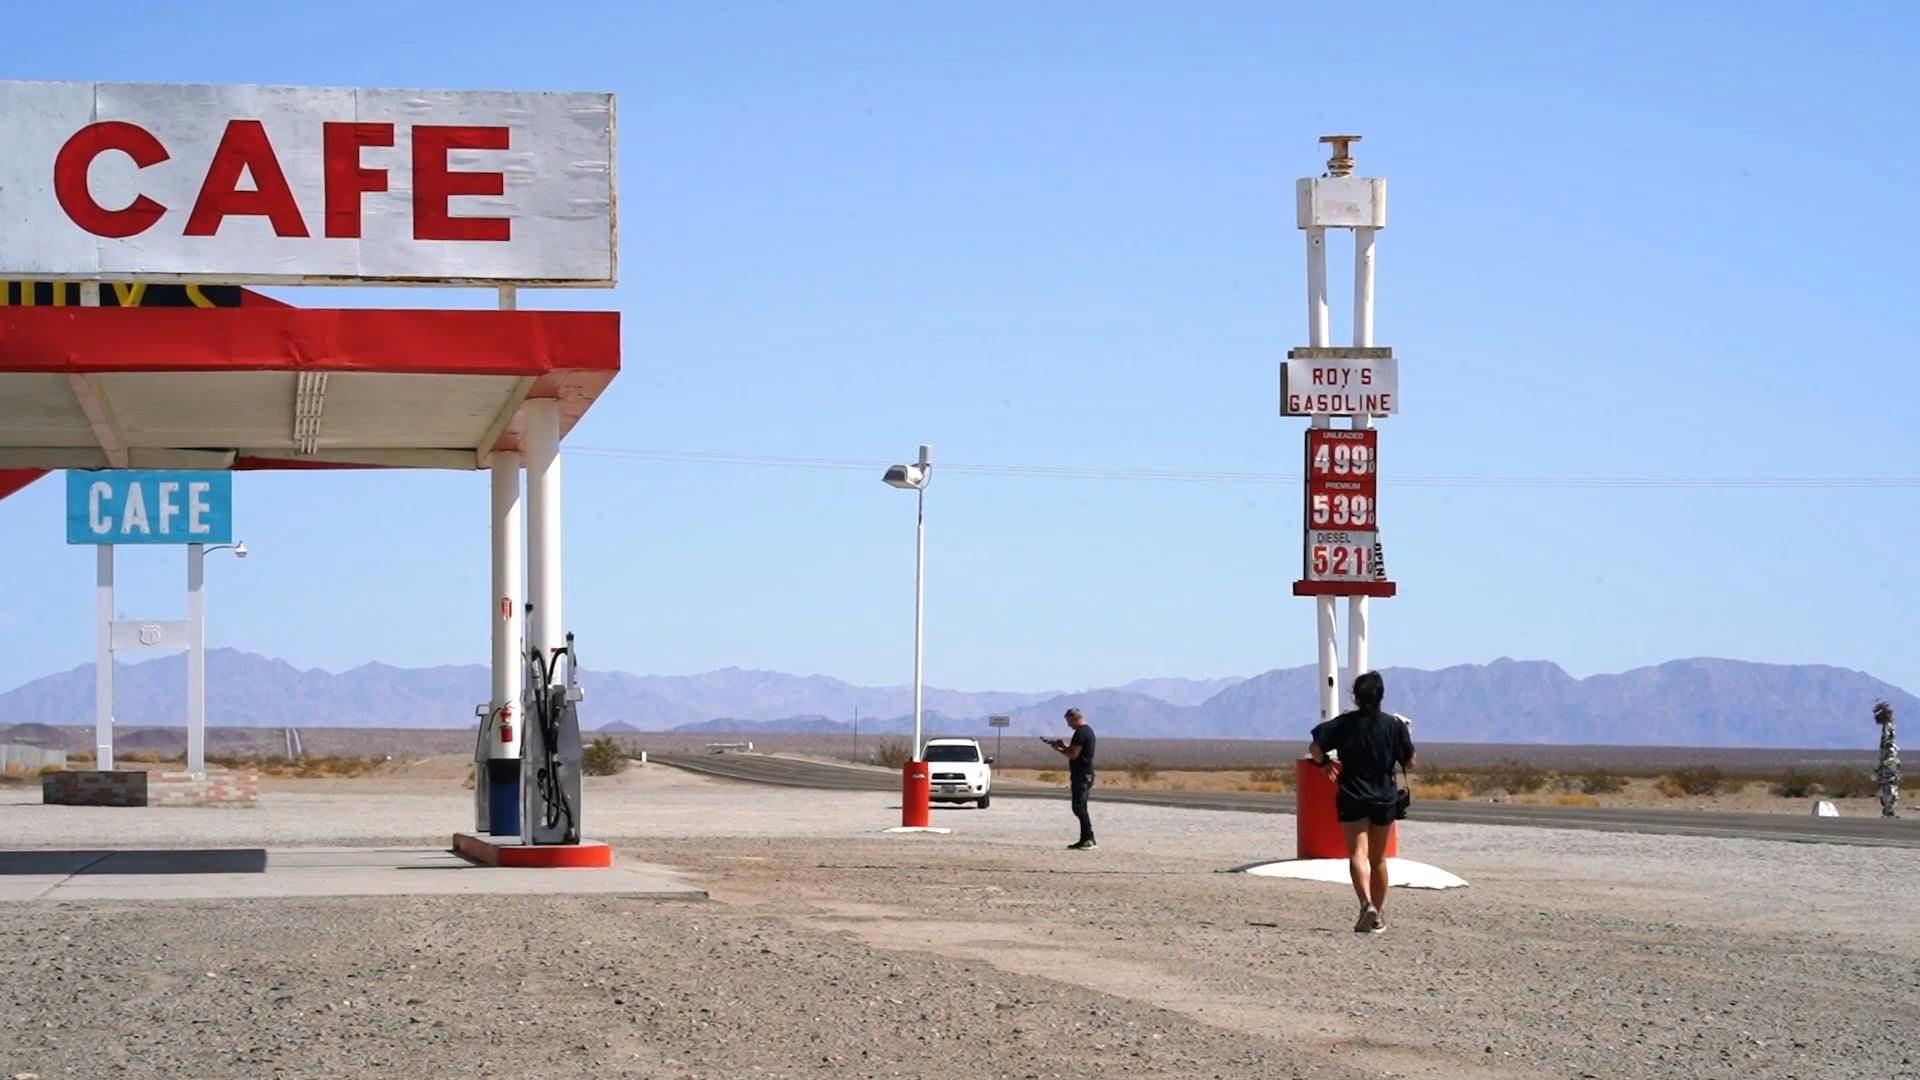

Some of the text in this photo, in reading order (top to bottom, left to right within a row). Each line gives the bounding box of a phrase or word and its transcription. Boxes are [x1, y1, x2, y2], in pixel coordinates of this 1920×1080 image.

[53, 119, 511, 242] CAFE
[1312, 367, 1372, 385] ROY'S
[1289, 394, 1391, 412] GASOLINE
[1322, 431, 1365, 439] UNLEADED
[1314, 443, 1368, 475] 499
[1325, 481, 1361, 490] PREMIUM
[89, 481, 210, 534] CAFE
[1313, 494, 1367, 525] 539
[1317, 533, 1351, 543] DIESEL
[1313, 545, 1363, 575] 521
[1374, 542, 1385, 576] OPEN
